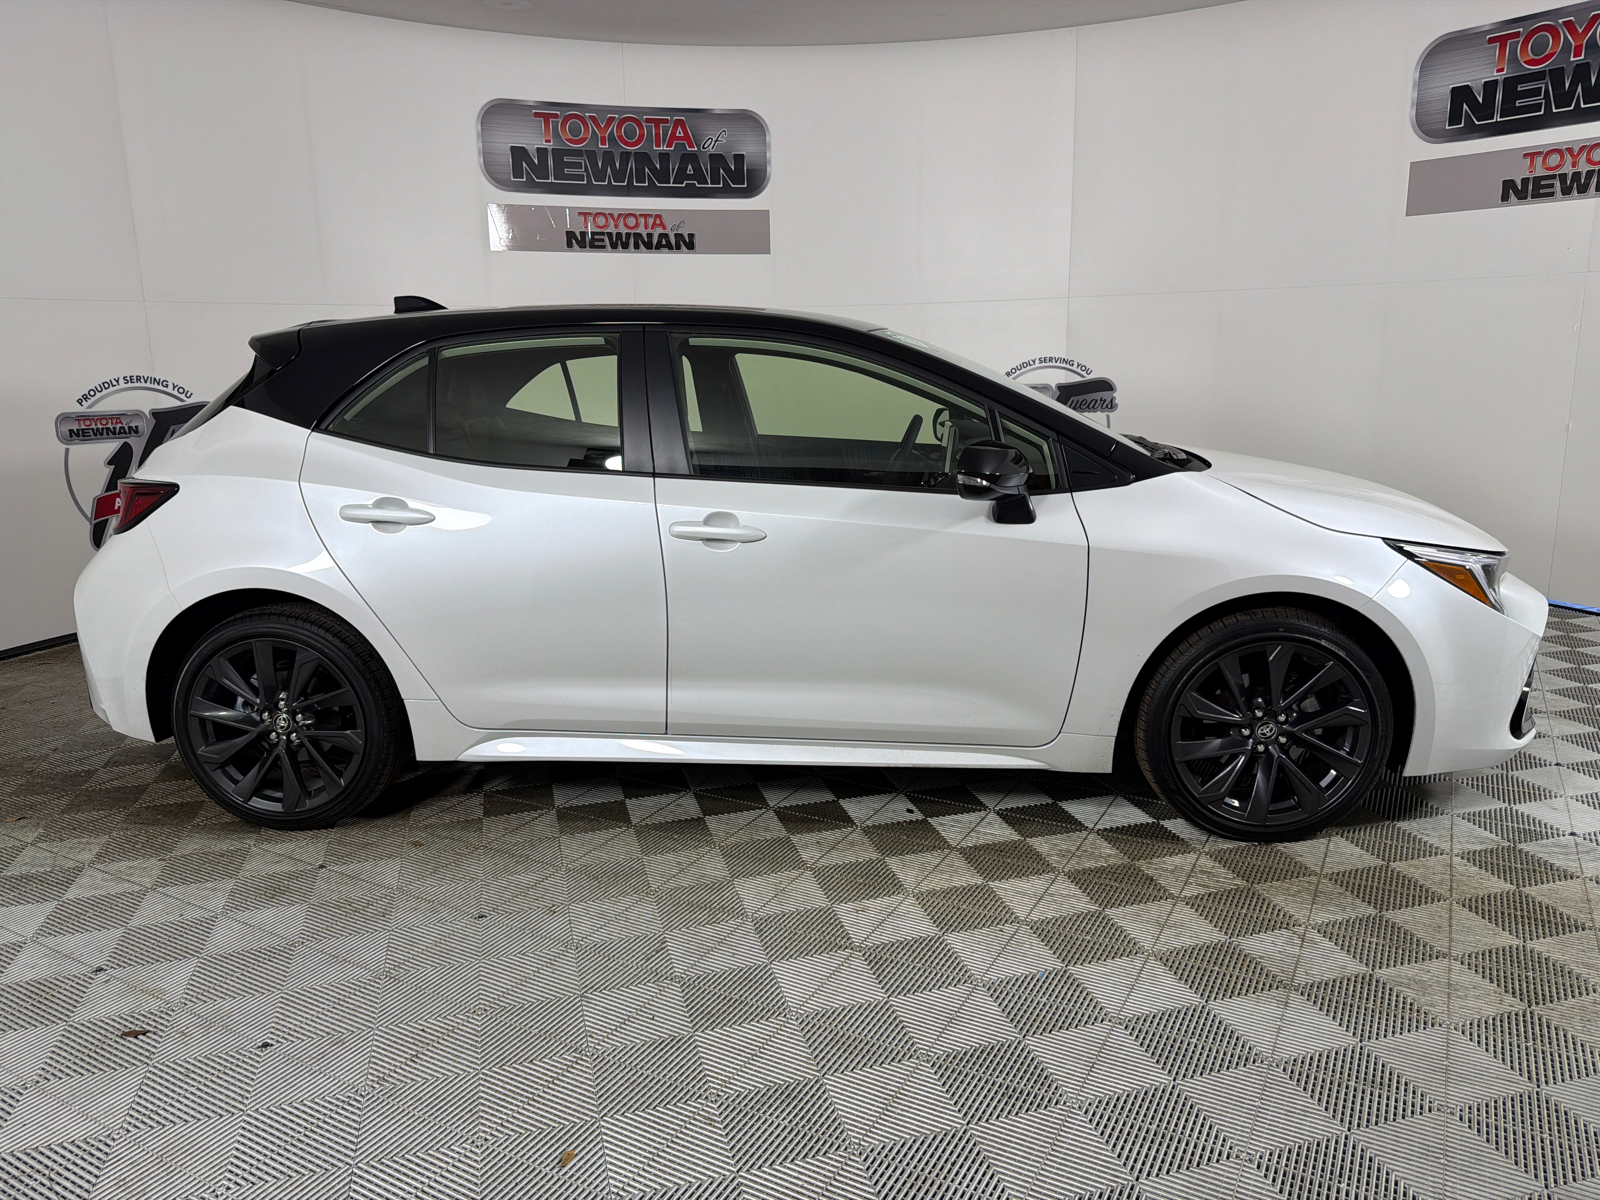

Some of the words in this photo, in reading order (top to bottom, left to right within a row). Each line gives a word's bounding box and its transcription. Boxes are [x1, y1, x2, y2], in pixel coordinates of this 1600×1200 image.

[1486, 11, 1600, 75] TOY
[532, 110, 697, 150] TOYOTA
[702, 129, 728, 151] of
[509, 145, 748, 188] NEWNAN
[1500, 168, 1600, 203] NEW
[577, 211, 667, 231] TOYOTA
[670, 220, 686, 232] of
[565, 230, 696, 251] NEWNAN
[1004, 358, 1037, 378] ROUDLY
[1038, 356, 1074, 367] SERVING
[1076, 361, 1093, 376] YOU
[76, 377, 120, 407] PROUDLY
[122, 375, 169, 388] SERVING
[171, 382, 193, 399] YOU
[1068, 396, 1116, 411] years
[68, 425, 139, 439] NEWNAN
[75, 416, 123, 428] TOYOTA
